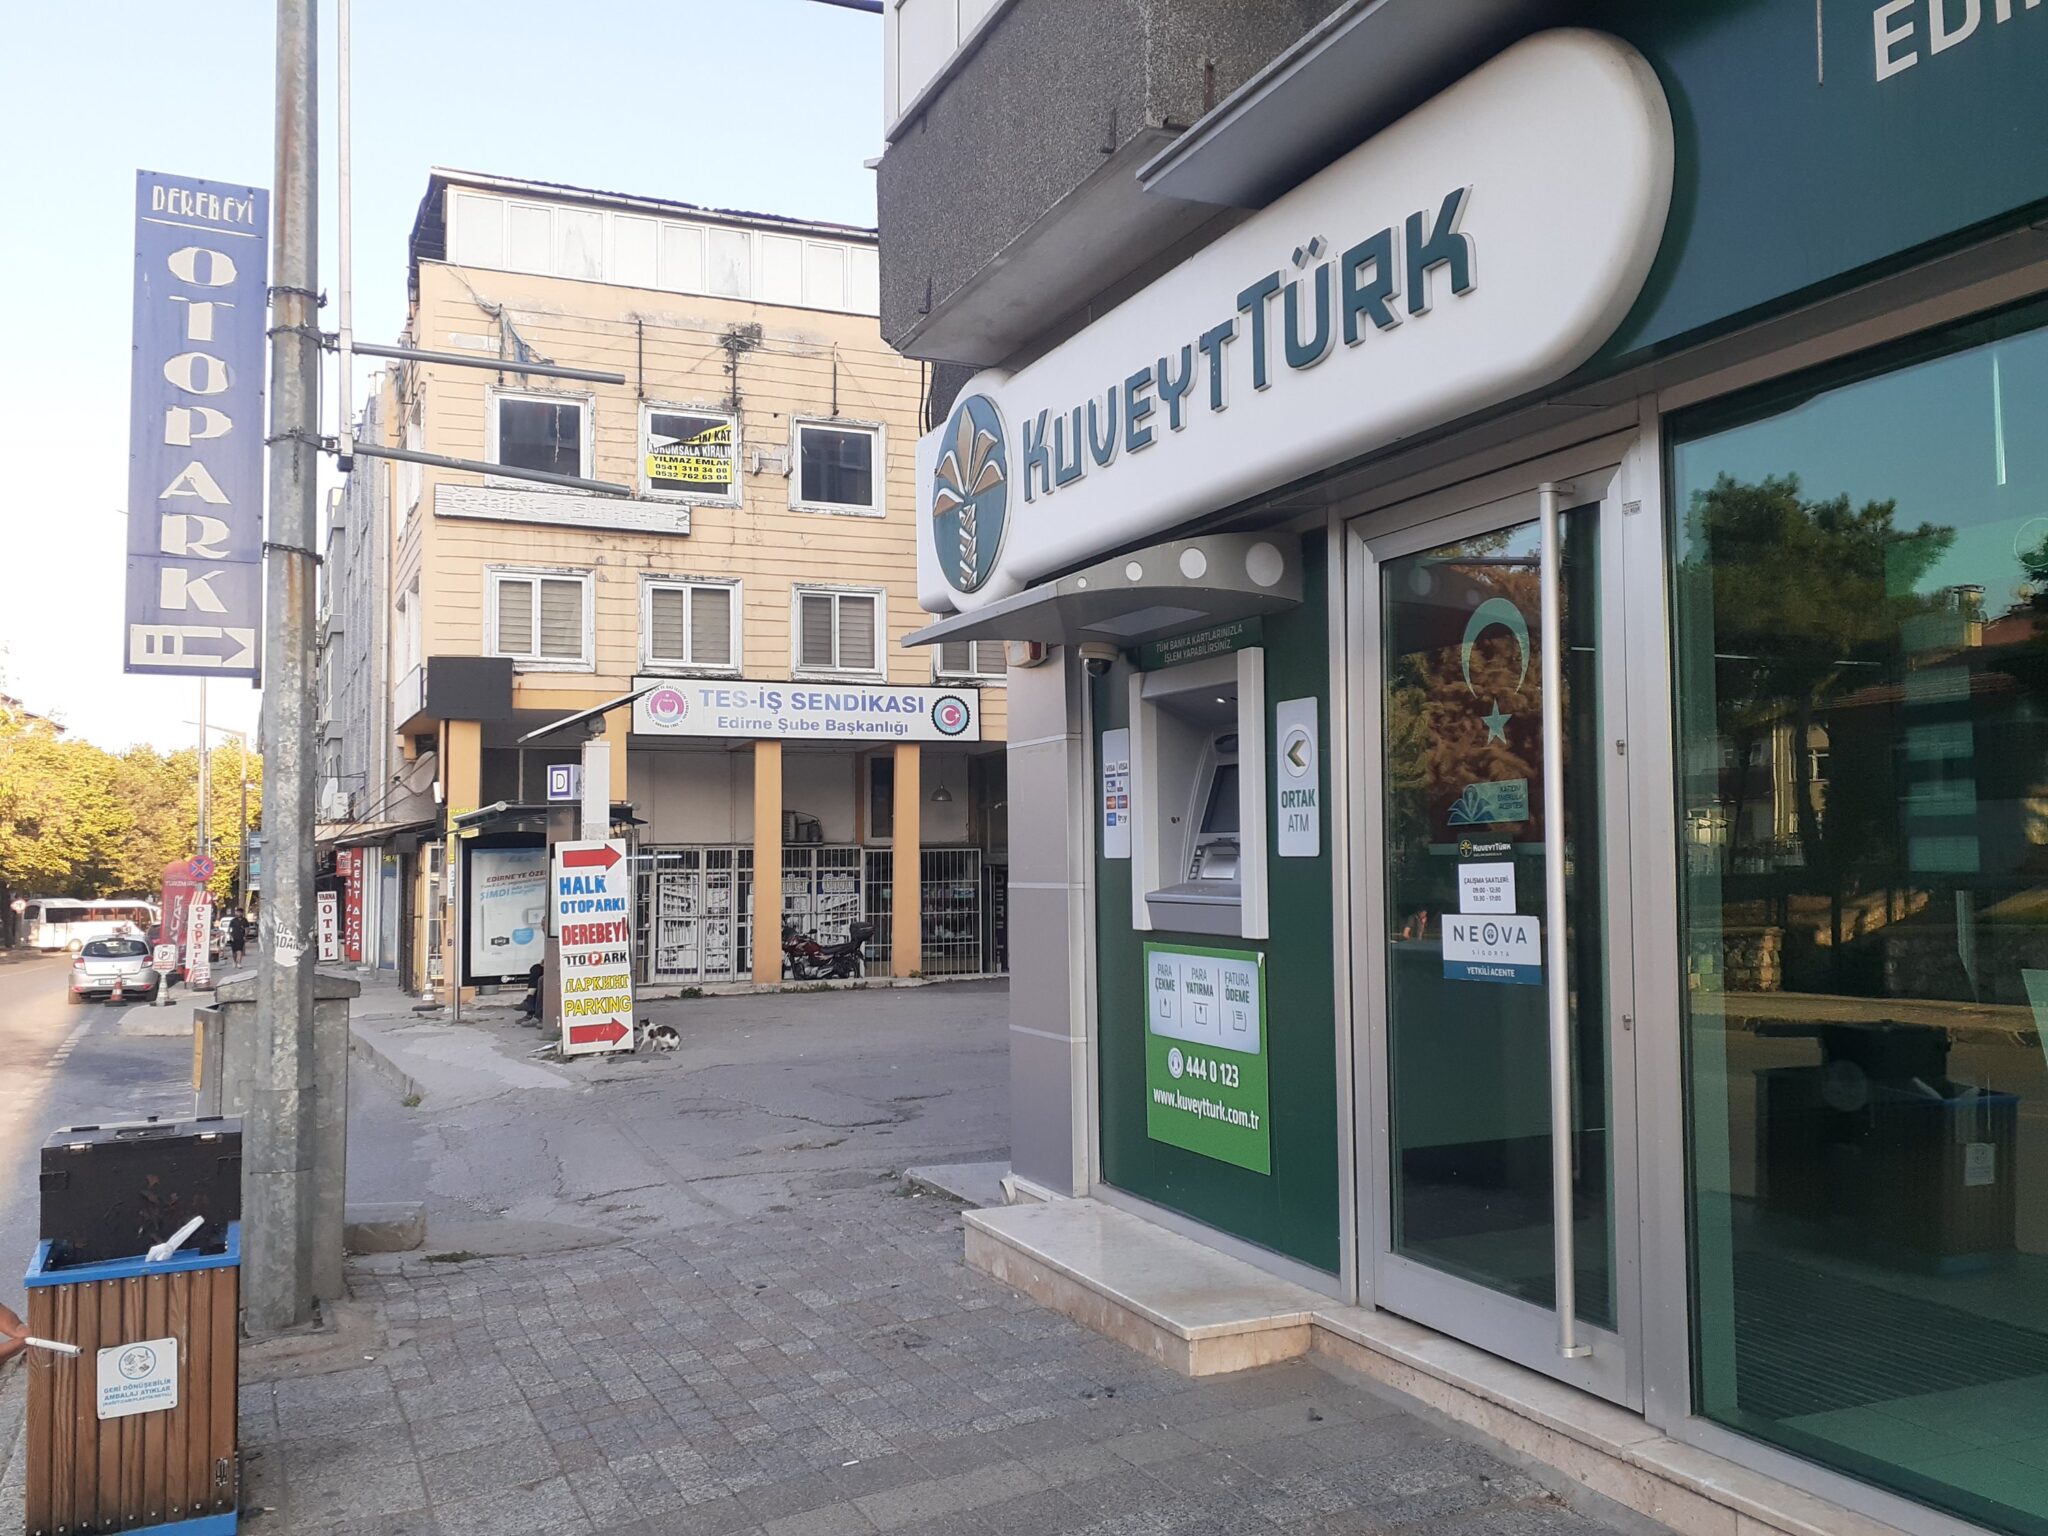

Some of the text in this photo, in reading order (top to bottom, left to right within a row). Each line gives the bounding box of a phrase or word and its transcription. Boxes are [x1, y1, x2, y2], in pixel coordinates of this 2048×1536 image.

[1873, 0, 2042, 83] ED
[152, 184, 255, 225] DEREBEYİ
[158, 245, 238, 614] OTOPARK
[714, 429, 732, 442] KAT
[653, 455, 730, 466] YILMAZ EMLAK
[682, 472, 699, 480] 762
[1169, 637, 1190, 650] BANKA
[699, 686, 783, 714] TES-İŞ
[791, 689, 924, 713] SENDİKASI
[717, 716, 909, 736] Edirne Şube Başkanlığı
[555, 773, 566, 790] D
[1281, 788, 1316, 809] ORTAK
[1287, 813, 1310, 833] ATM
[353, 859, 361, 900] RENT
[528, 869, 546, 878] ÖZE
[559, 874, 607, 896] HALK
[560, 897, 626, 915] OTOPARKI
[322, 904, 333, 958] OTEL
[352, 920, 361, 951] CAR
[561, 917, 627, 946] DEREBEYİ
[1453, 922, 1528, 946] NEOVA
[1472, 949, 1510, 957] SİGORTA
[1157, 963, 1173, 977] PARA
[1191, 967, 1208, 982] PARA
[1224, 971, 1250, 987] FATURA
[1466, 965, 1516, 978] YETKİLİ ACENTE
[1155, 977, 1176, 992] ÇEKME
[1186, 981, 1214, 998] YATIRMA
[1225, 985, 1250, 1004] ÖDEME
[564, 995, 632, 1018] PARKING
[1186, 1056, 1240, 1089] 444 0 123
[1153, 1086, 1260, 1131] www.kuveytturk.com.tr
[104, 1391, 139, 1401] AMBALAJ
[140, 1385, 171, 1397] ATIKLAR
